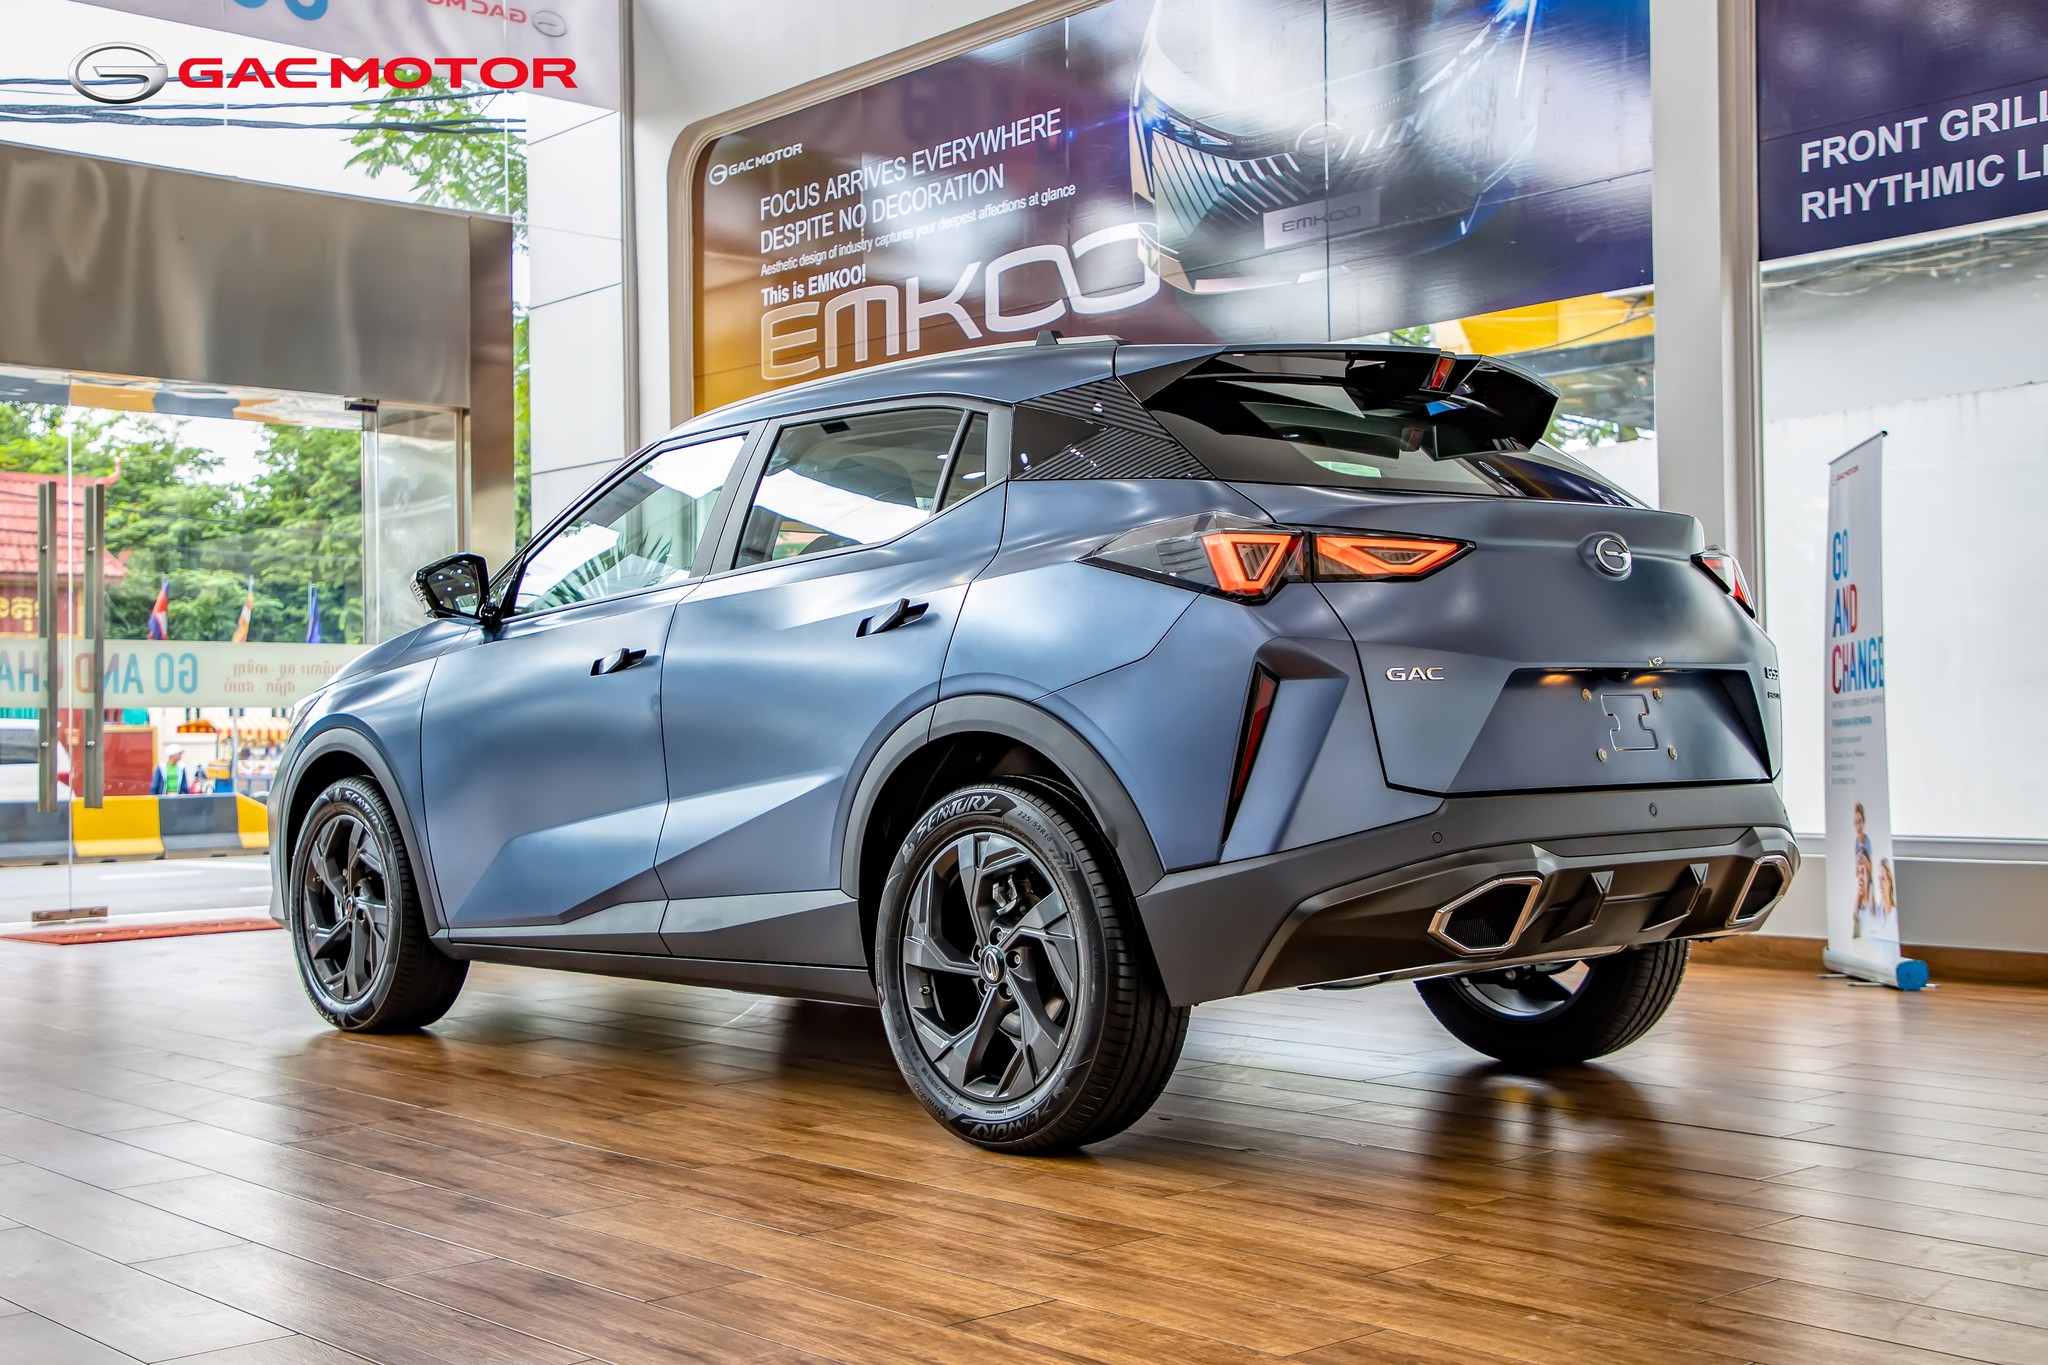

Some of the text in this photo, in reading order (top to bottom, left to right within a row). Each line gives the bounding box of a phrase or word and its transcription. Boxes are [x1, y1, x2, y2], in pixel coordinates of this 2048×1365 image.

[760, 107, 1062, 222] FOCUS ARRIVES EVERYWHERE
[1801, 116, 1929, 173] FRONT
[760, 163, 1004, 254] DESPITE NO DECORATION
[1801, 154, 2006, 223] RHYTHMIC
[760, 184, 1077, 277] Aesthetic design of industry captures your deepest affections at glance
[760, 263, 867, 307] This is EMKOO!
[761, 222, 1161, 381] EMKOO
[1832, 528, 1849, 581] GO
[1832, 583, 1858, 638] AND
[1385, 665, 1445, 681] GAC
[1831, 635, 1884, 694] CHANGE
